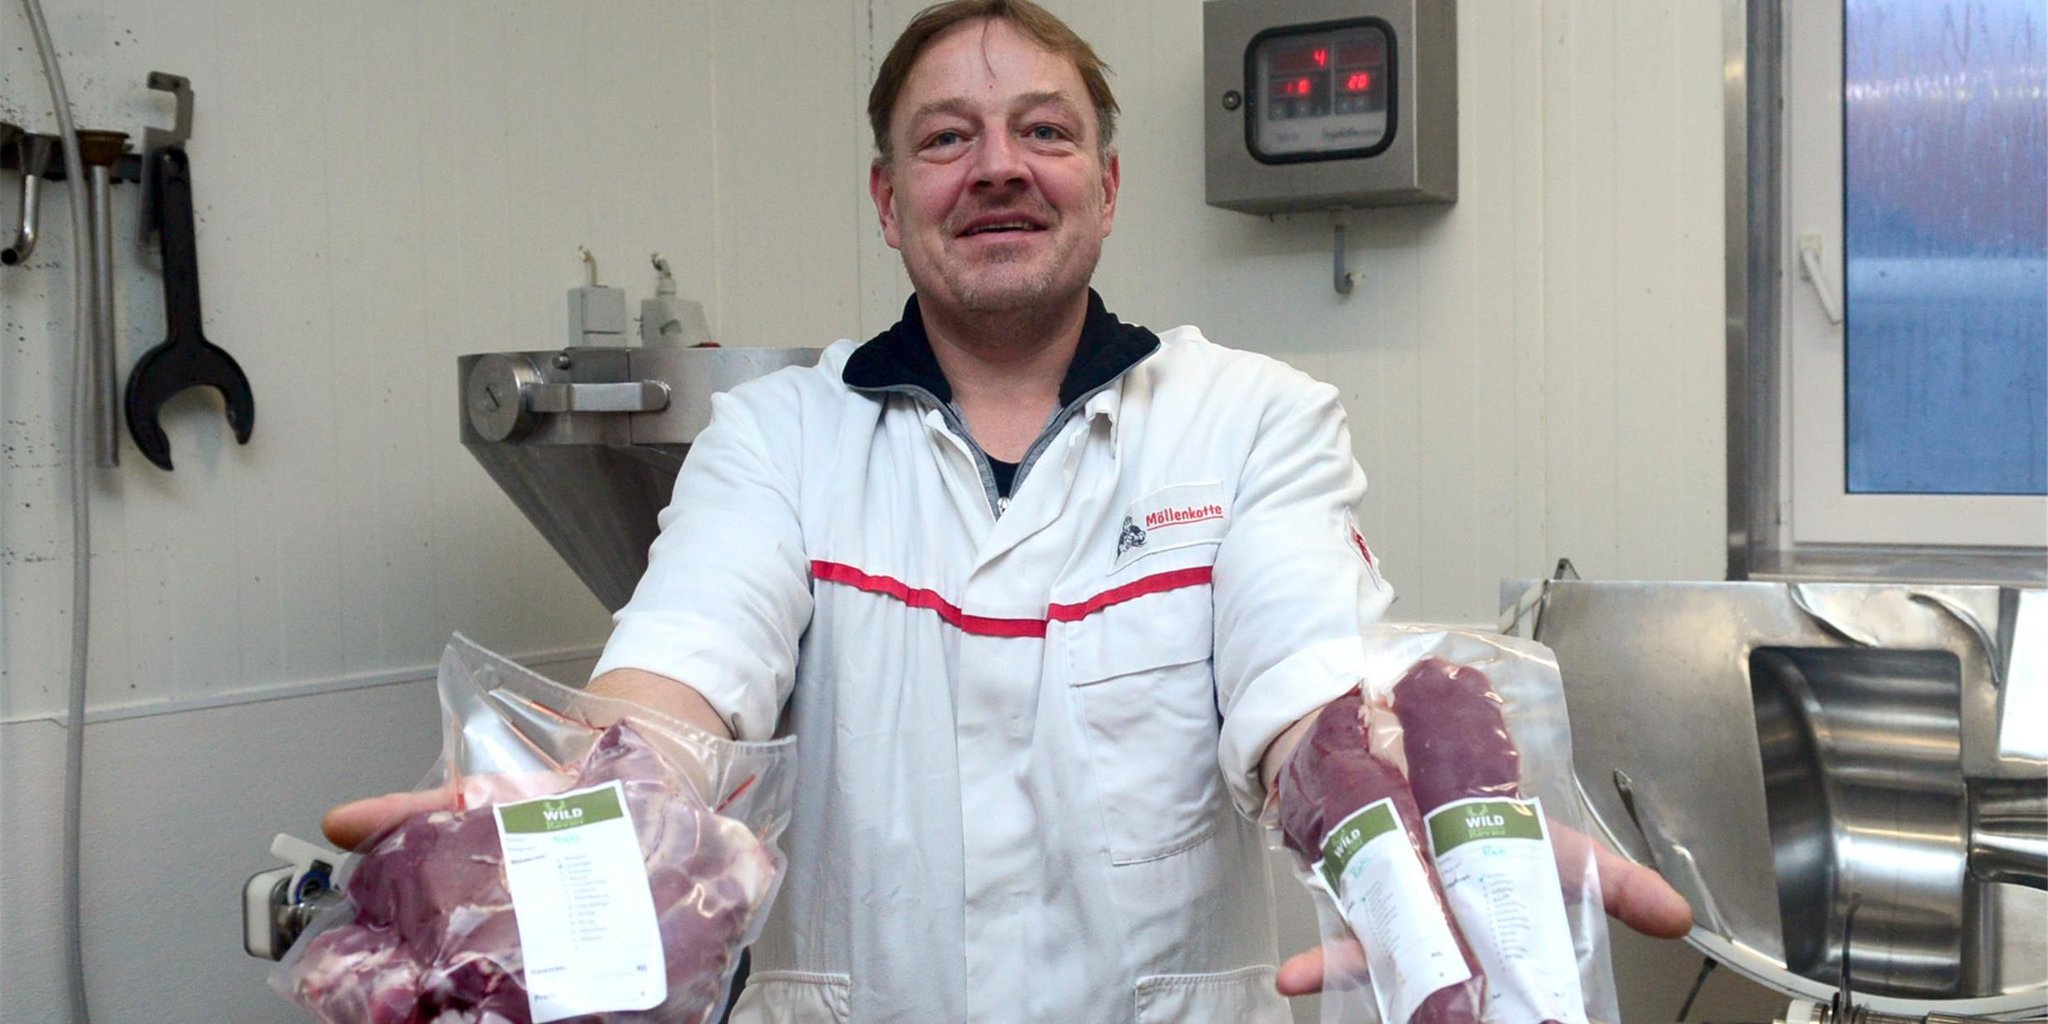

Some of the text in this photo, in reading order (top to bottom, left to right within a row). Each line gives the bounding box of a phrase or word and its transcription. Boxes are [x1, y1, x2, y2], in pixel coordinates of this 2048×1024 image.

[1314, 48, 1327, 66] 4
[1348, 73, 1369, 91] 20
[1146, 504, 1222, 527] Möllenkotte
[542, 807, 583, 821] WILD
[1465, 815, 1504, 828] WILD
[1334, 829, 1361, 858] WILD
